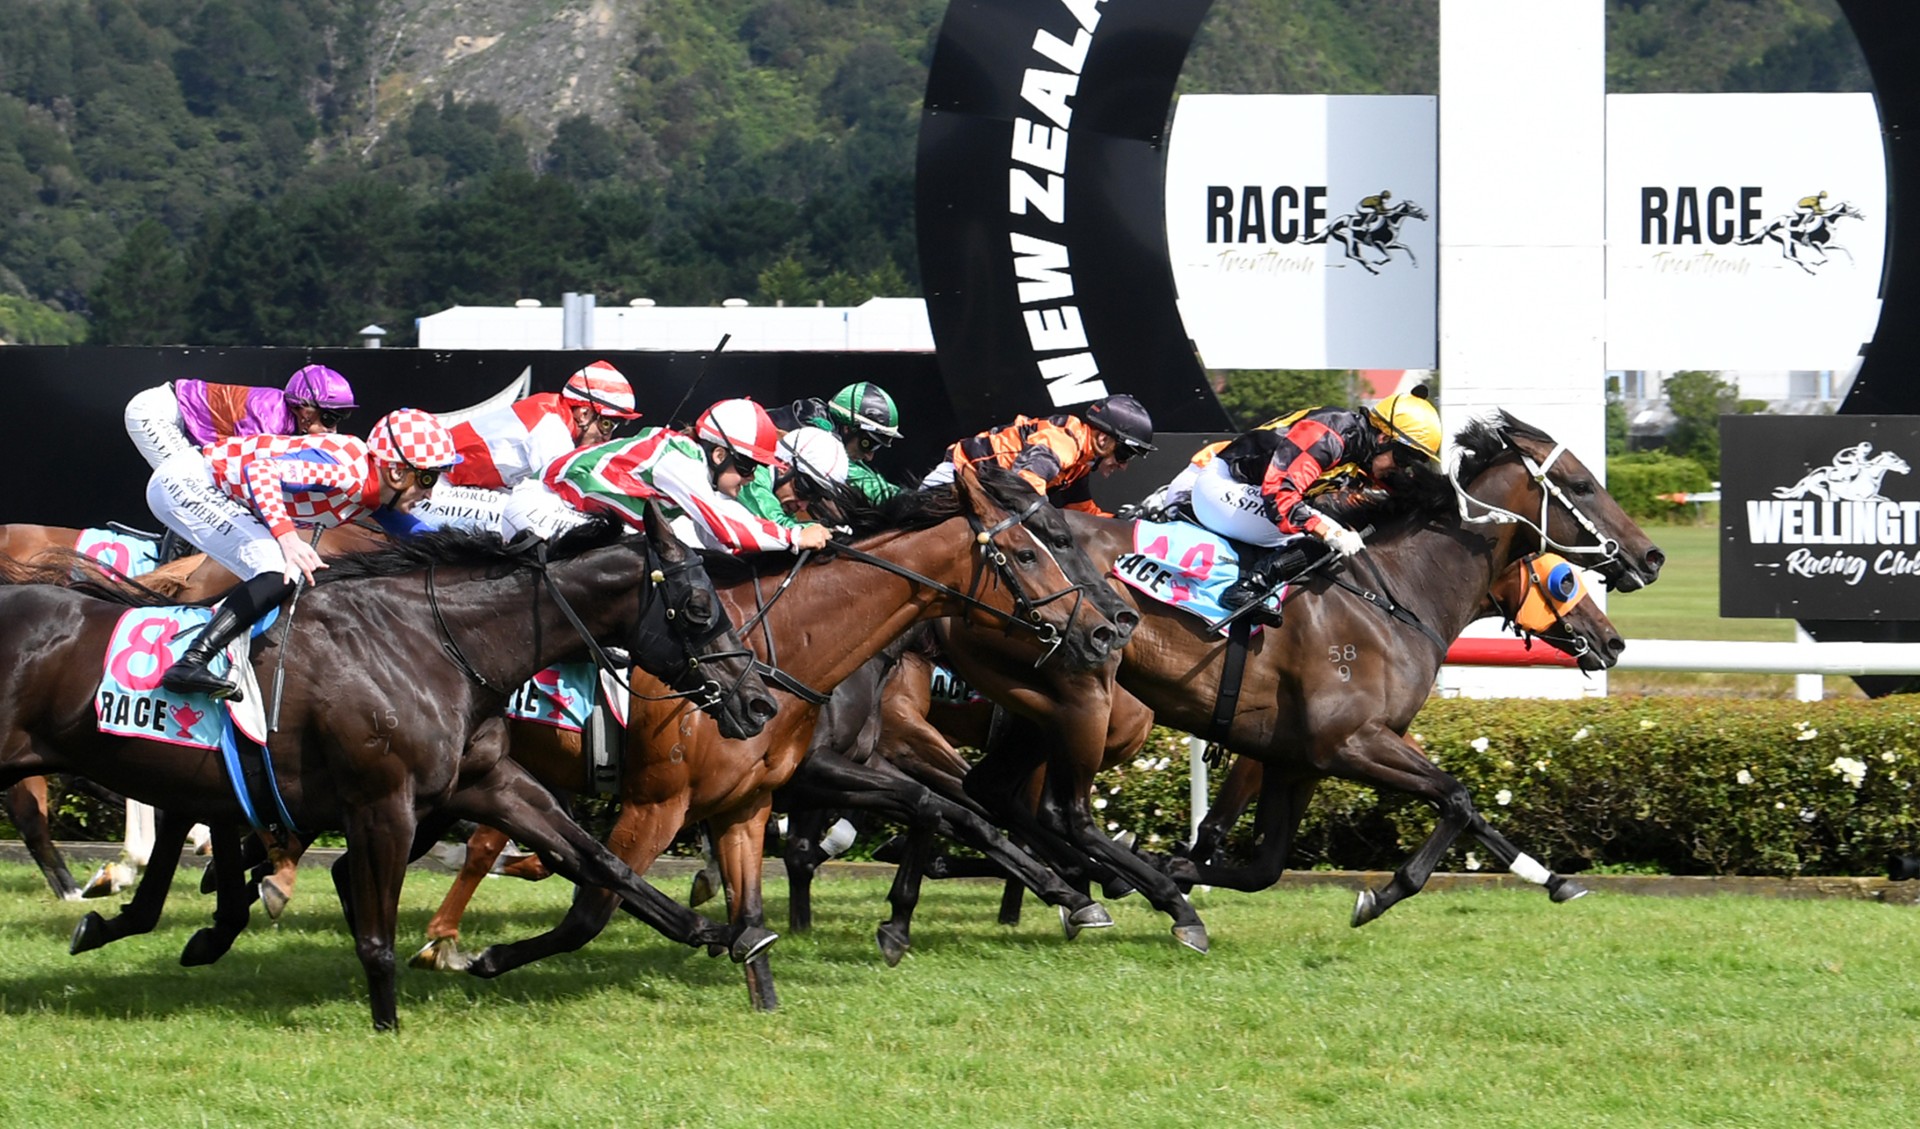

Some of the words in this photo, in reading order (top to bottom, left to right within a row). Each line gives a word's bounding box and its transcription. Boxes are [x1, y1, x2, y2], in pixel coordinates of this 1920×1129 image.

[1206, 185, 1328, 244] RACE
[1641, 186, 1763, 245] RACE
[1009, 231, 1109, 408] NEW
[1746, 500, 1920, 545] WELLINGT
[1116, 553, 1172, 593] ACE
[1785, 548, 1868, 586] Racing
[110, 616, 180, 691] 8
[1328, 643, 1357, 662] 58
[1338, 664, 1351, 682] 9
[99, 691, 167, 731] RACE
